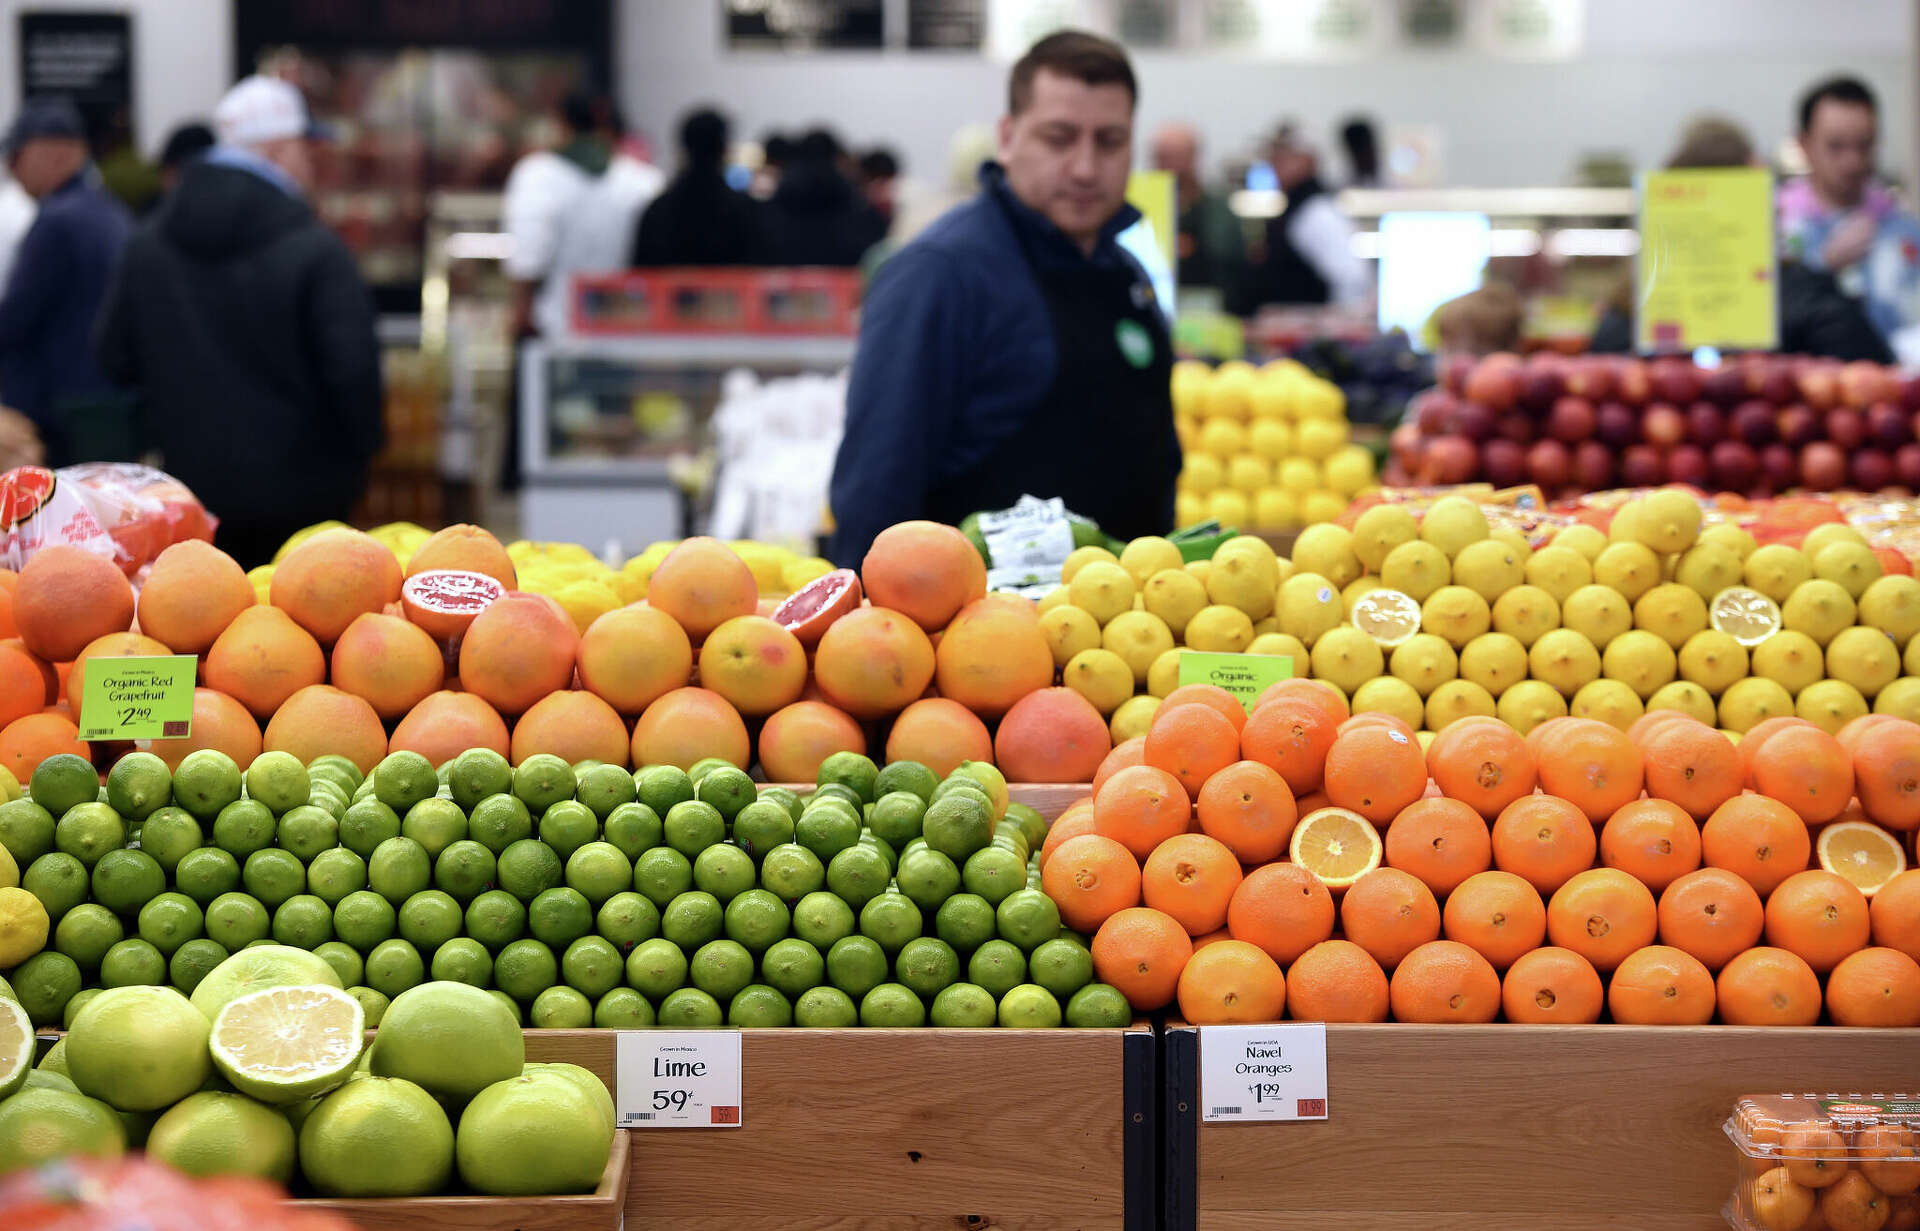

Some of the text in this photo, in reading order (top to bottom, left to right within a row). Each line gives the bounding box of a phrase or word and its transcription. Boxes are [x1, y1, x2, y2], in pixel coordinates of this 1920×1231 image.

[1210, 670, 1258, 682] Organic
[103, 676, 173, 689] Organic Red
[109, 690, 165, 702] Grapefruit
[1246, 1047, 1282, 1058] Navel
[653, 1057, 708, 1077] Lime
[1235, 1062, 1293, 1077] Oranges
